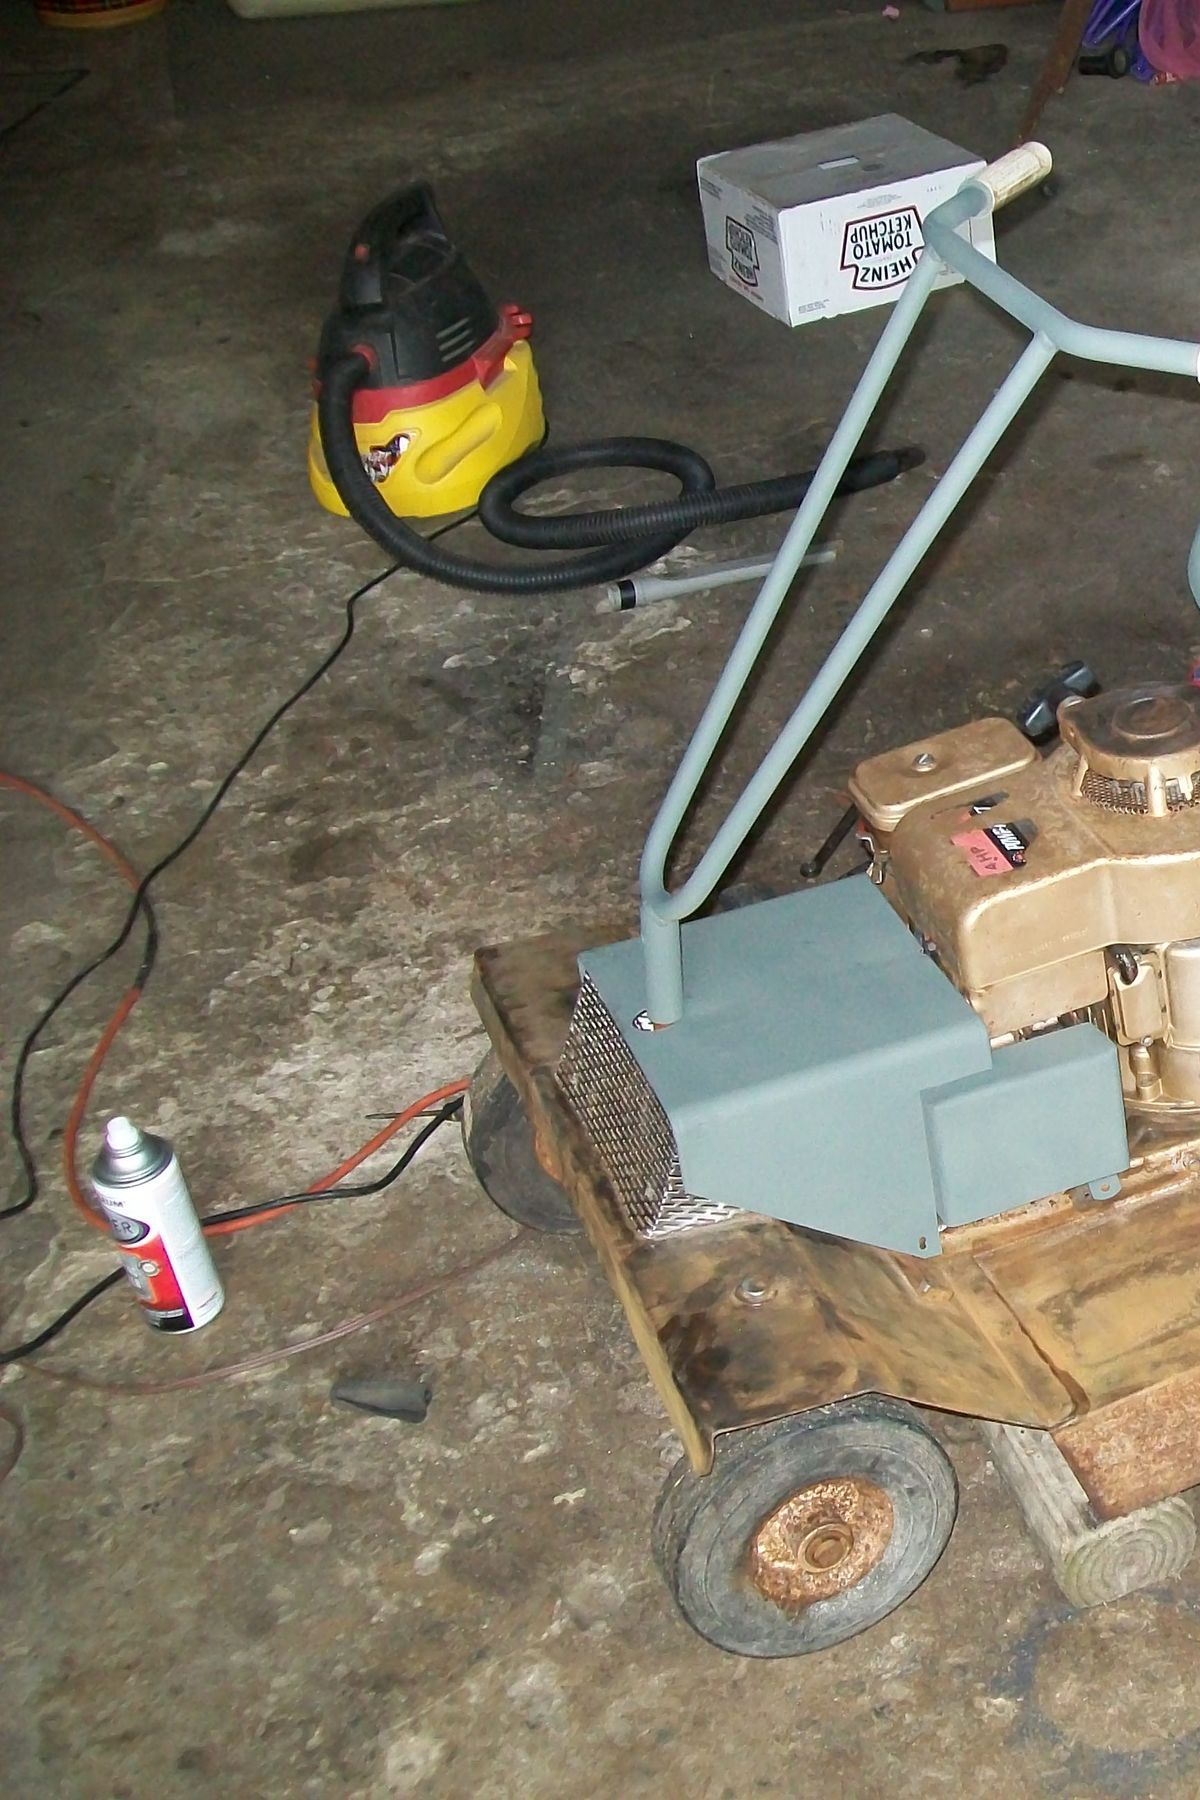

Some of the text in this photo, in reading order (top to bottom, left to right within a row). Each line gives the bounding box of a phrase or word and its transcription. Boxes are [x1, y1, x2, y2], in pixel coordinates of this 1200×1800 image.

[850, 214, 912, 243] KETCHUP
[853, 231, 912, 260] TOMATO
[860, 256, 912, 282] HEINZ
